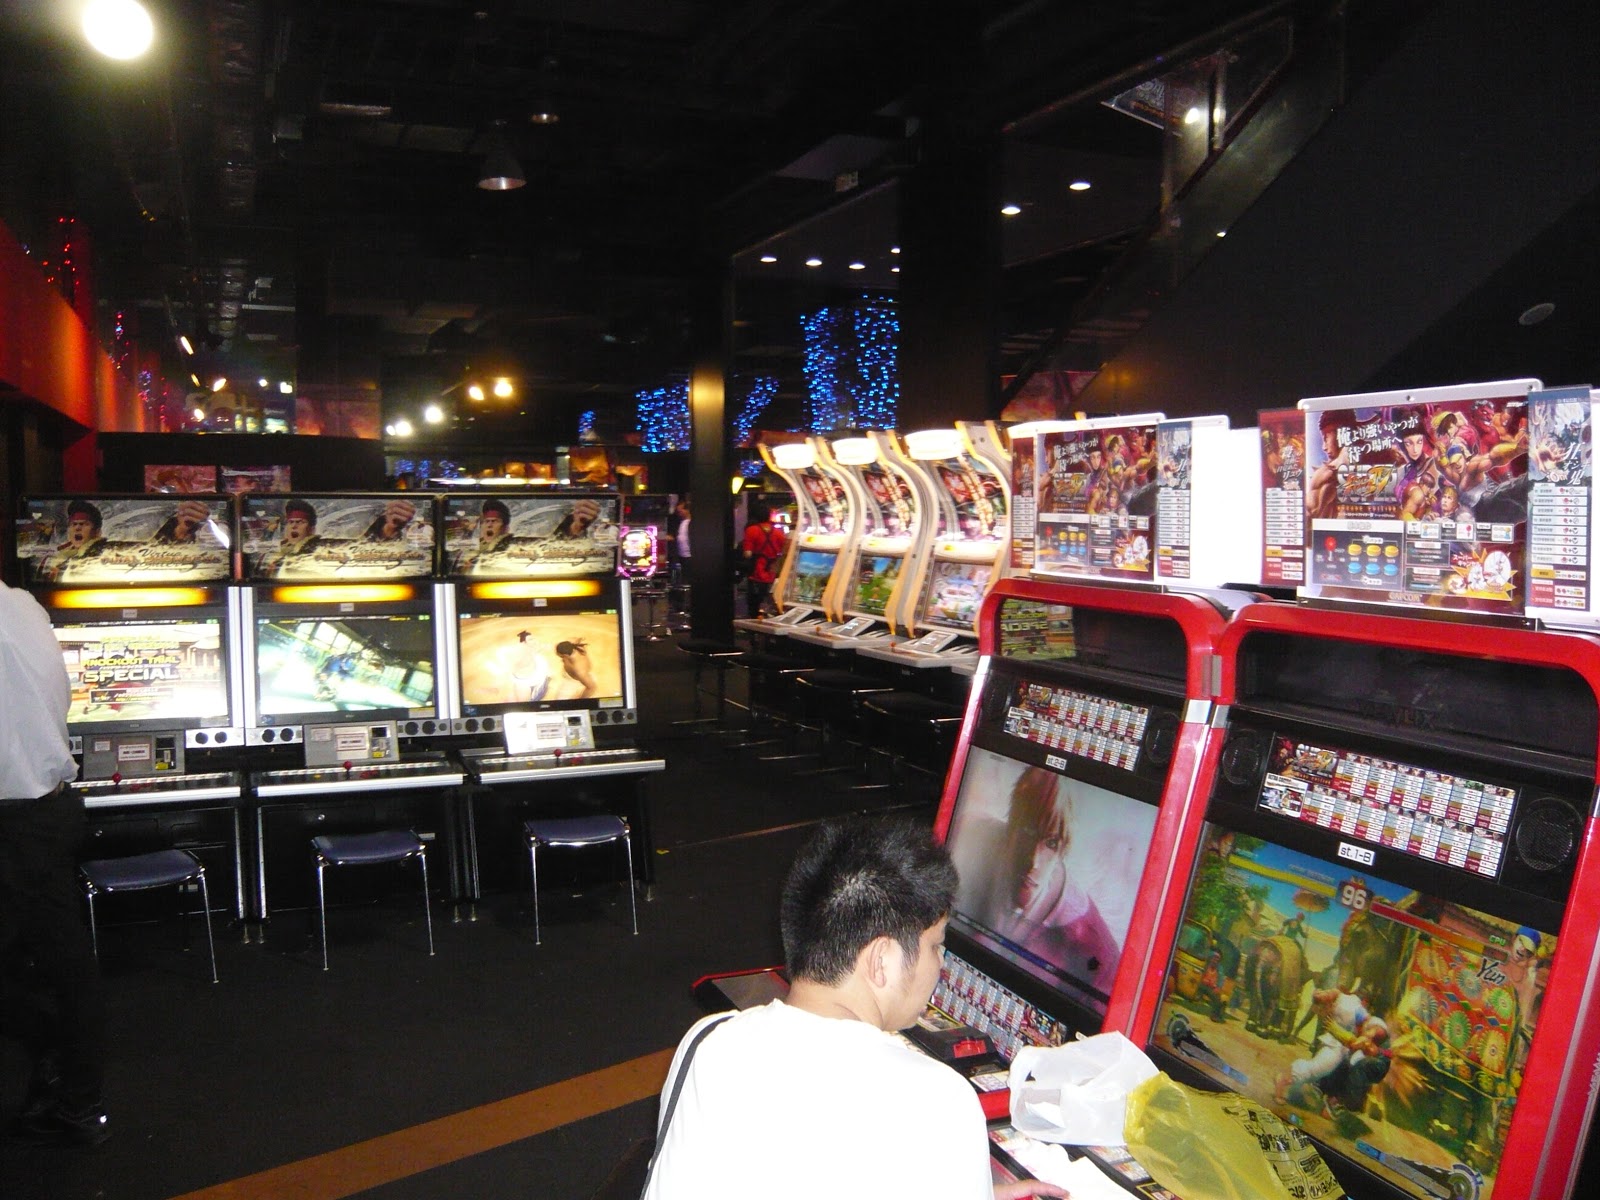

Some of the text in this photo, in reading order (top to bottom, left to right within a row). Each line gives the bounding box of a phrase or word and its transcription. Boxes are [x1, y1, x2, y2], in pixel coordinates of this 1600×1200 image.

[1337, 416, 1419, 448] 俺より強いやつが
[1348, 436, 1403, 463] 待つ場所へ
[83, 655, 180, 667] KNOCKOUT TRIAL
[84, 667, 181, 683] SPECIAL
[1340, 846, 1372, 863] st.1-B
[1342, 885, 1367, 910] 96
[1476, 958, 1506, 985] Yun
